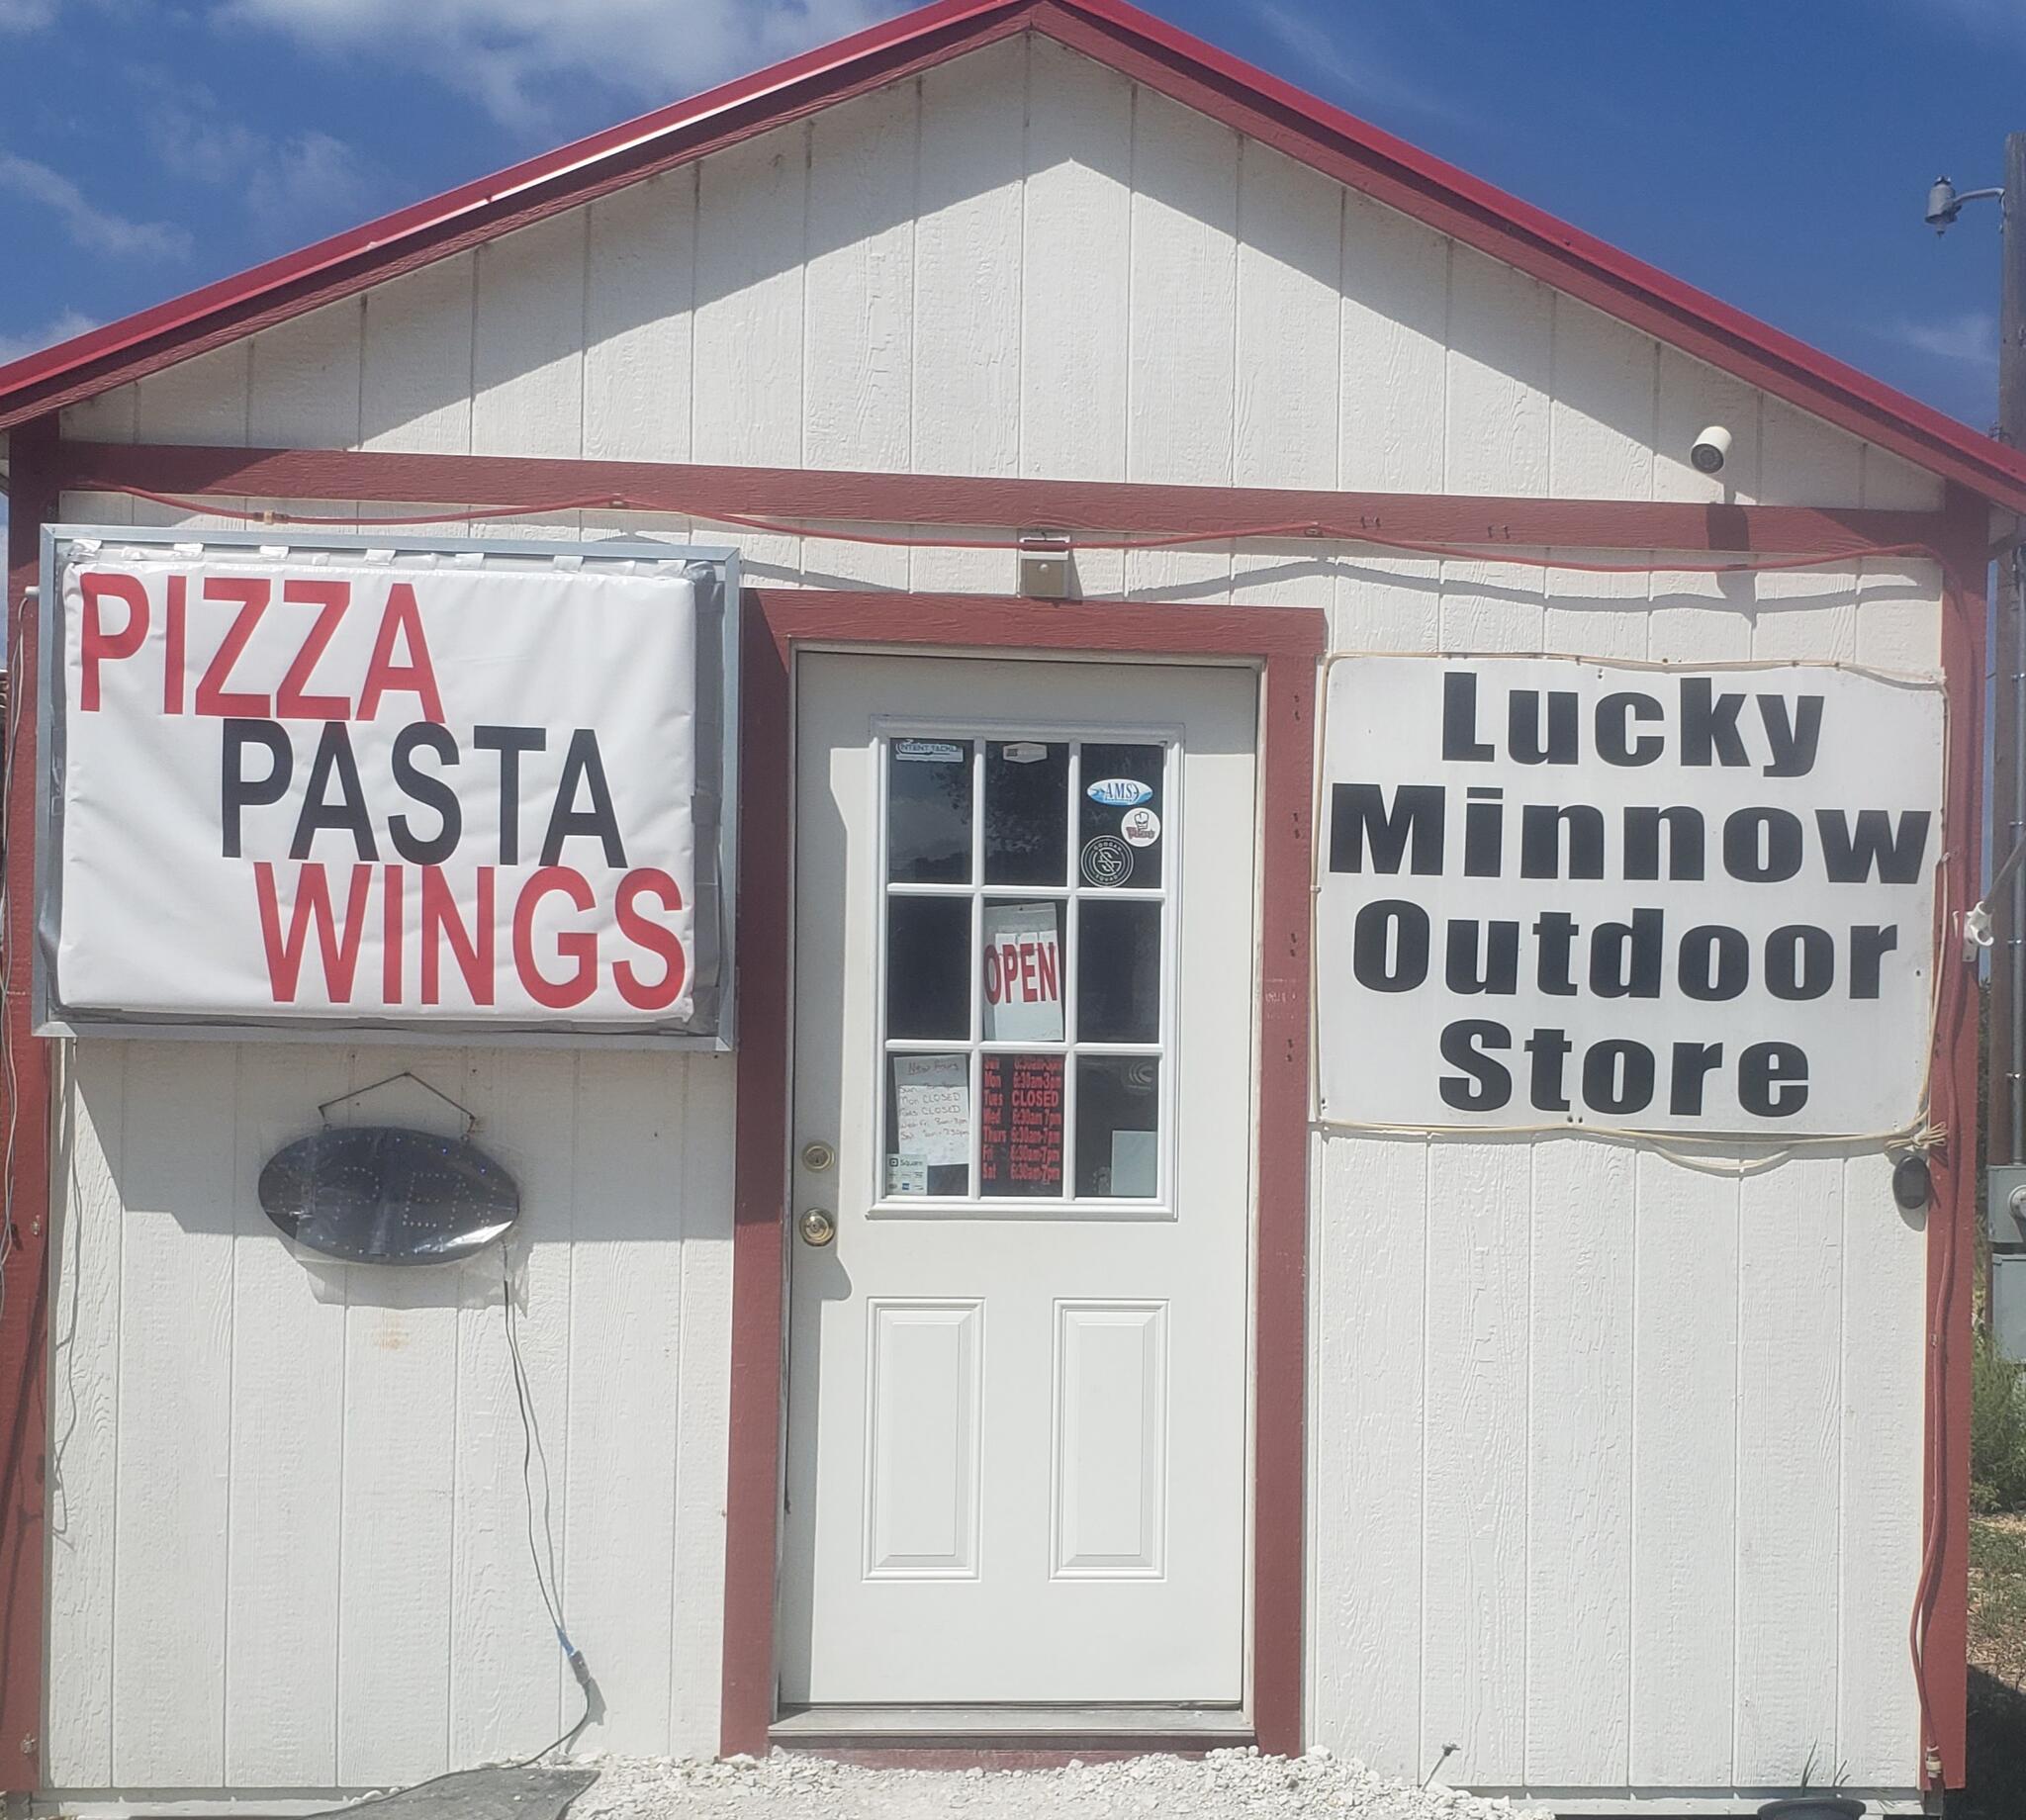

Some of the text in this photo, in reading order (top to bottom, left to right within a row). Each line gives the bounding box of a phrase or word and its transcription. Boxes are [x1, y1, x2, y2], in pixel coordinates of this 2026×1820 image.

[79, 572, 447, 724] PIZZA
[1441, 671, 1825, 777] Lucky
[222, 717, 628, 869] PASTA
[1329, 781, 1932, 885] Minnow
[253, 861, 687, 1011] WINGS
[1352, 899, 1898, 1002] Outdoor
[983, 942, 1058, 1006] OPEN
[983, 1070, 1001, 1088] Mon
[1438, 1019, 1809, 1118] Store
[920, 1105, 962, 1116] CLOSED
[922, 1091, 962, 1104] CLOSED
[983, 1089, 1059, 1107] Tues CLOSED
[983, 1108, 1001, 1124] Wed
[982, 1126, 1007, 1142] Thurs
[982, 1143, 994, 1161] Fri
[982, 1161, 997, 1180] Sat
